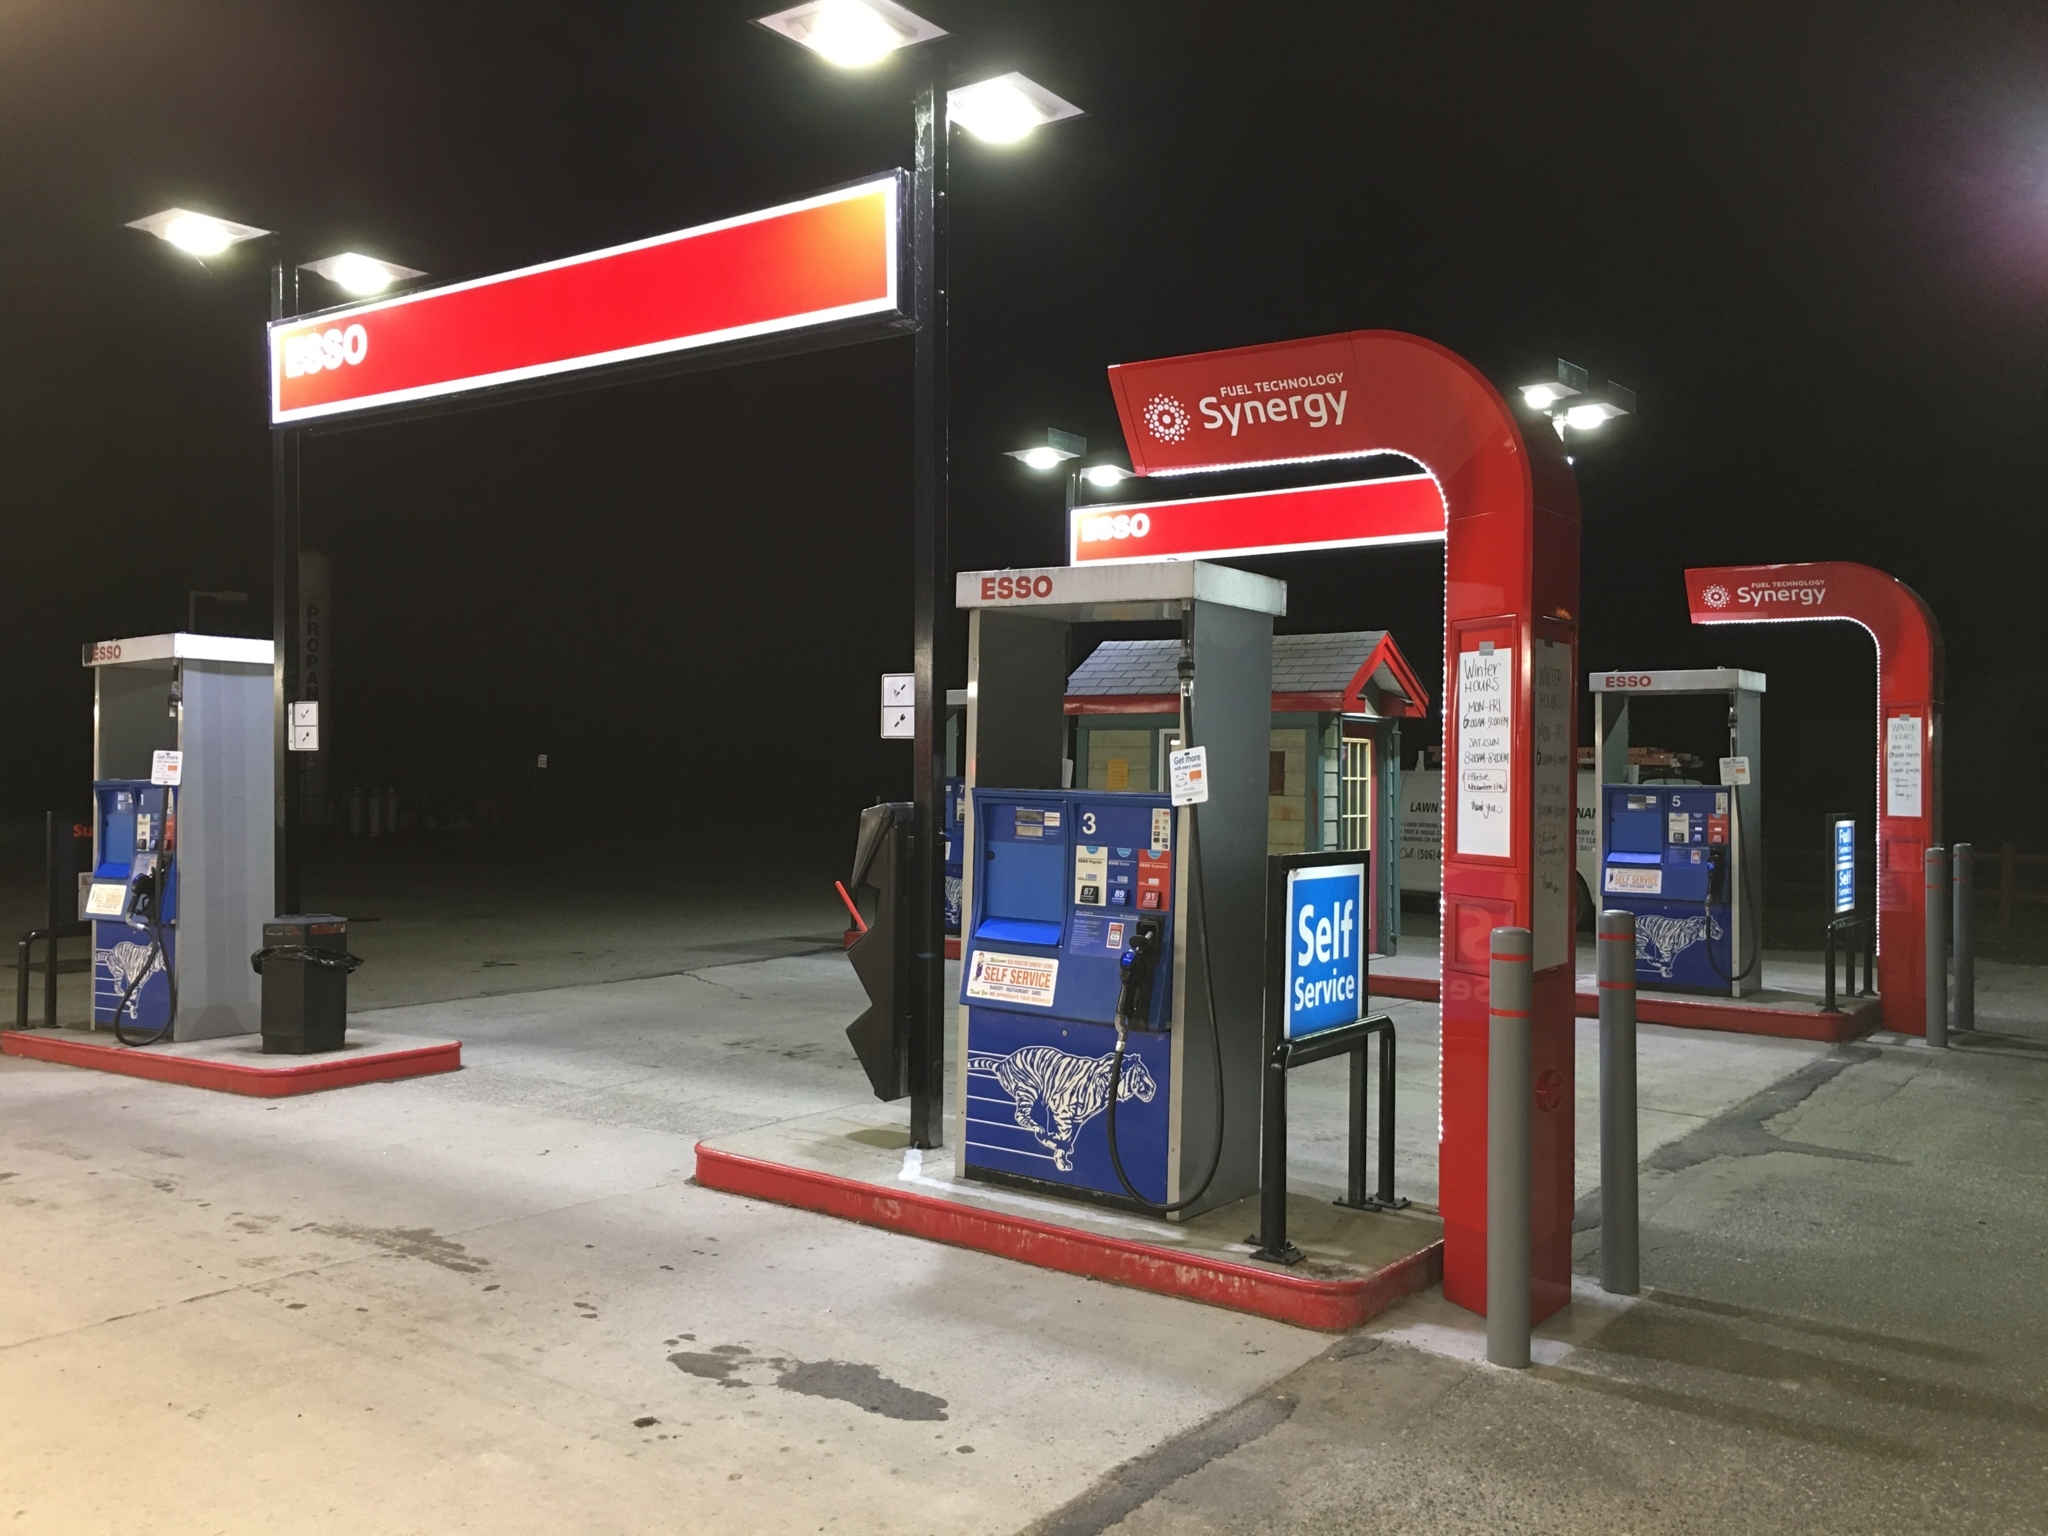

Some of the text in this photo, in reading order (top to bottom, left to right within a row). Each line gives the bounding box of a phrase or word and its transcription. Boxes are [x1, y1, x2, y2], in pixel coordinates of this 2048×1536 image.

[285, 323, 368, 379] ESSO
[1220, 372, 1344, 398] FUEL TECHNOLOGY
[1199, 390, 1348, 436] Synergy
[1081, 513, 1150, 543] ESSO
[981, 575, 1053, 600] ESSO
[1772, 579, 1825, 588] TECHNOLOGY
[1737, 586, 1826, 607] Synergy
[306, 604, 319, 701] PROPAN
[1464, 658, 1501, 680] Winter
[1464, 677, 1499, 693] HOURS
[1605, 675, 1652, 688] ESSO
[1174, 754, 1201, 765] Get more
[958, 785, 965, 794] 7
[1410, 802, 1438, 813] LAWN
[1672, 795, 1681, 807] 5
[1082, 812, 1096, 834] 3
[1615, 875, 1658, 885] SELF SERVICE
[1083, 887, 1094, 896] 87
[1114, 889, 1125, 898] 89
[1145, 892, 1156, 901] 91
[1298, 899, 1353, 967] Self
[984, 966, 1052, 988] SELF SERVICE
[1294, 968, 1355, 1012] Service
